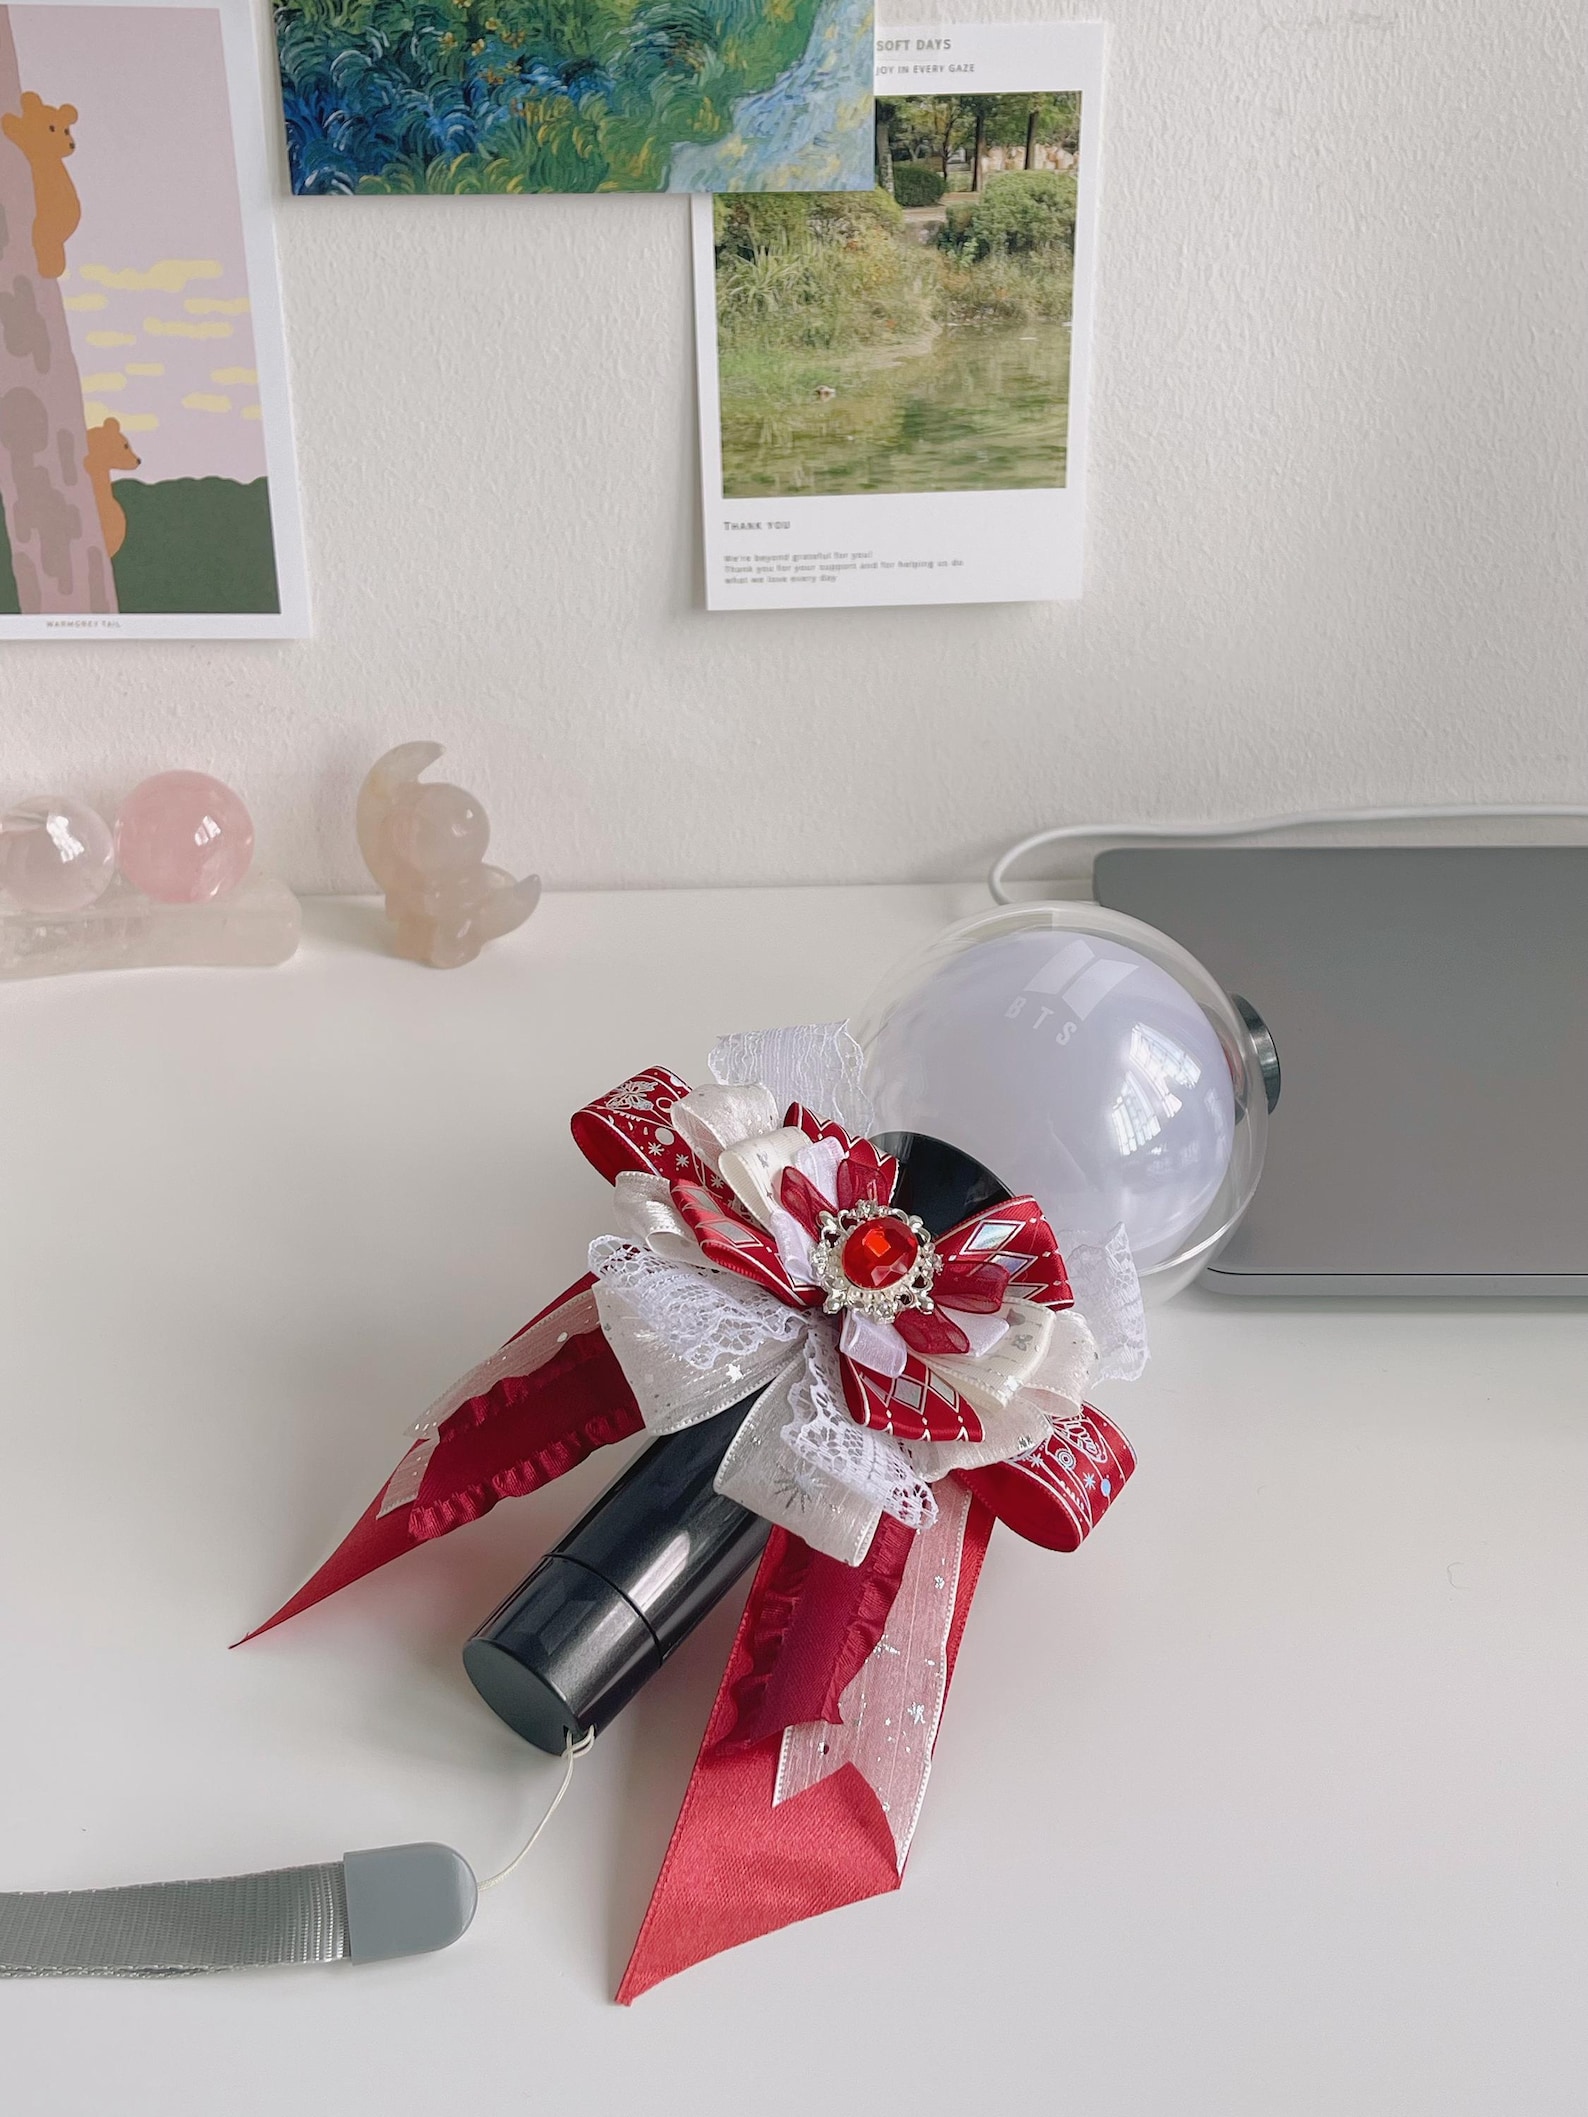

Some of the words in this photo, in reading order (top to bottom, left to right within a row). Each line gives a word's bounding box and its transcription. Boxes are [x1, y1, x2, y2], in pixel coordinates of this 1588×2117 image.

[876, 40, 910, 51] SOFT
[916, 39, 951, 50] DAYS
[913, 65, 945, 73] EVERY
[948, 64, 975, 72] GAZE
[1004, 996, 1077, 1045] BTS
